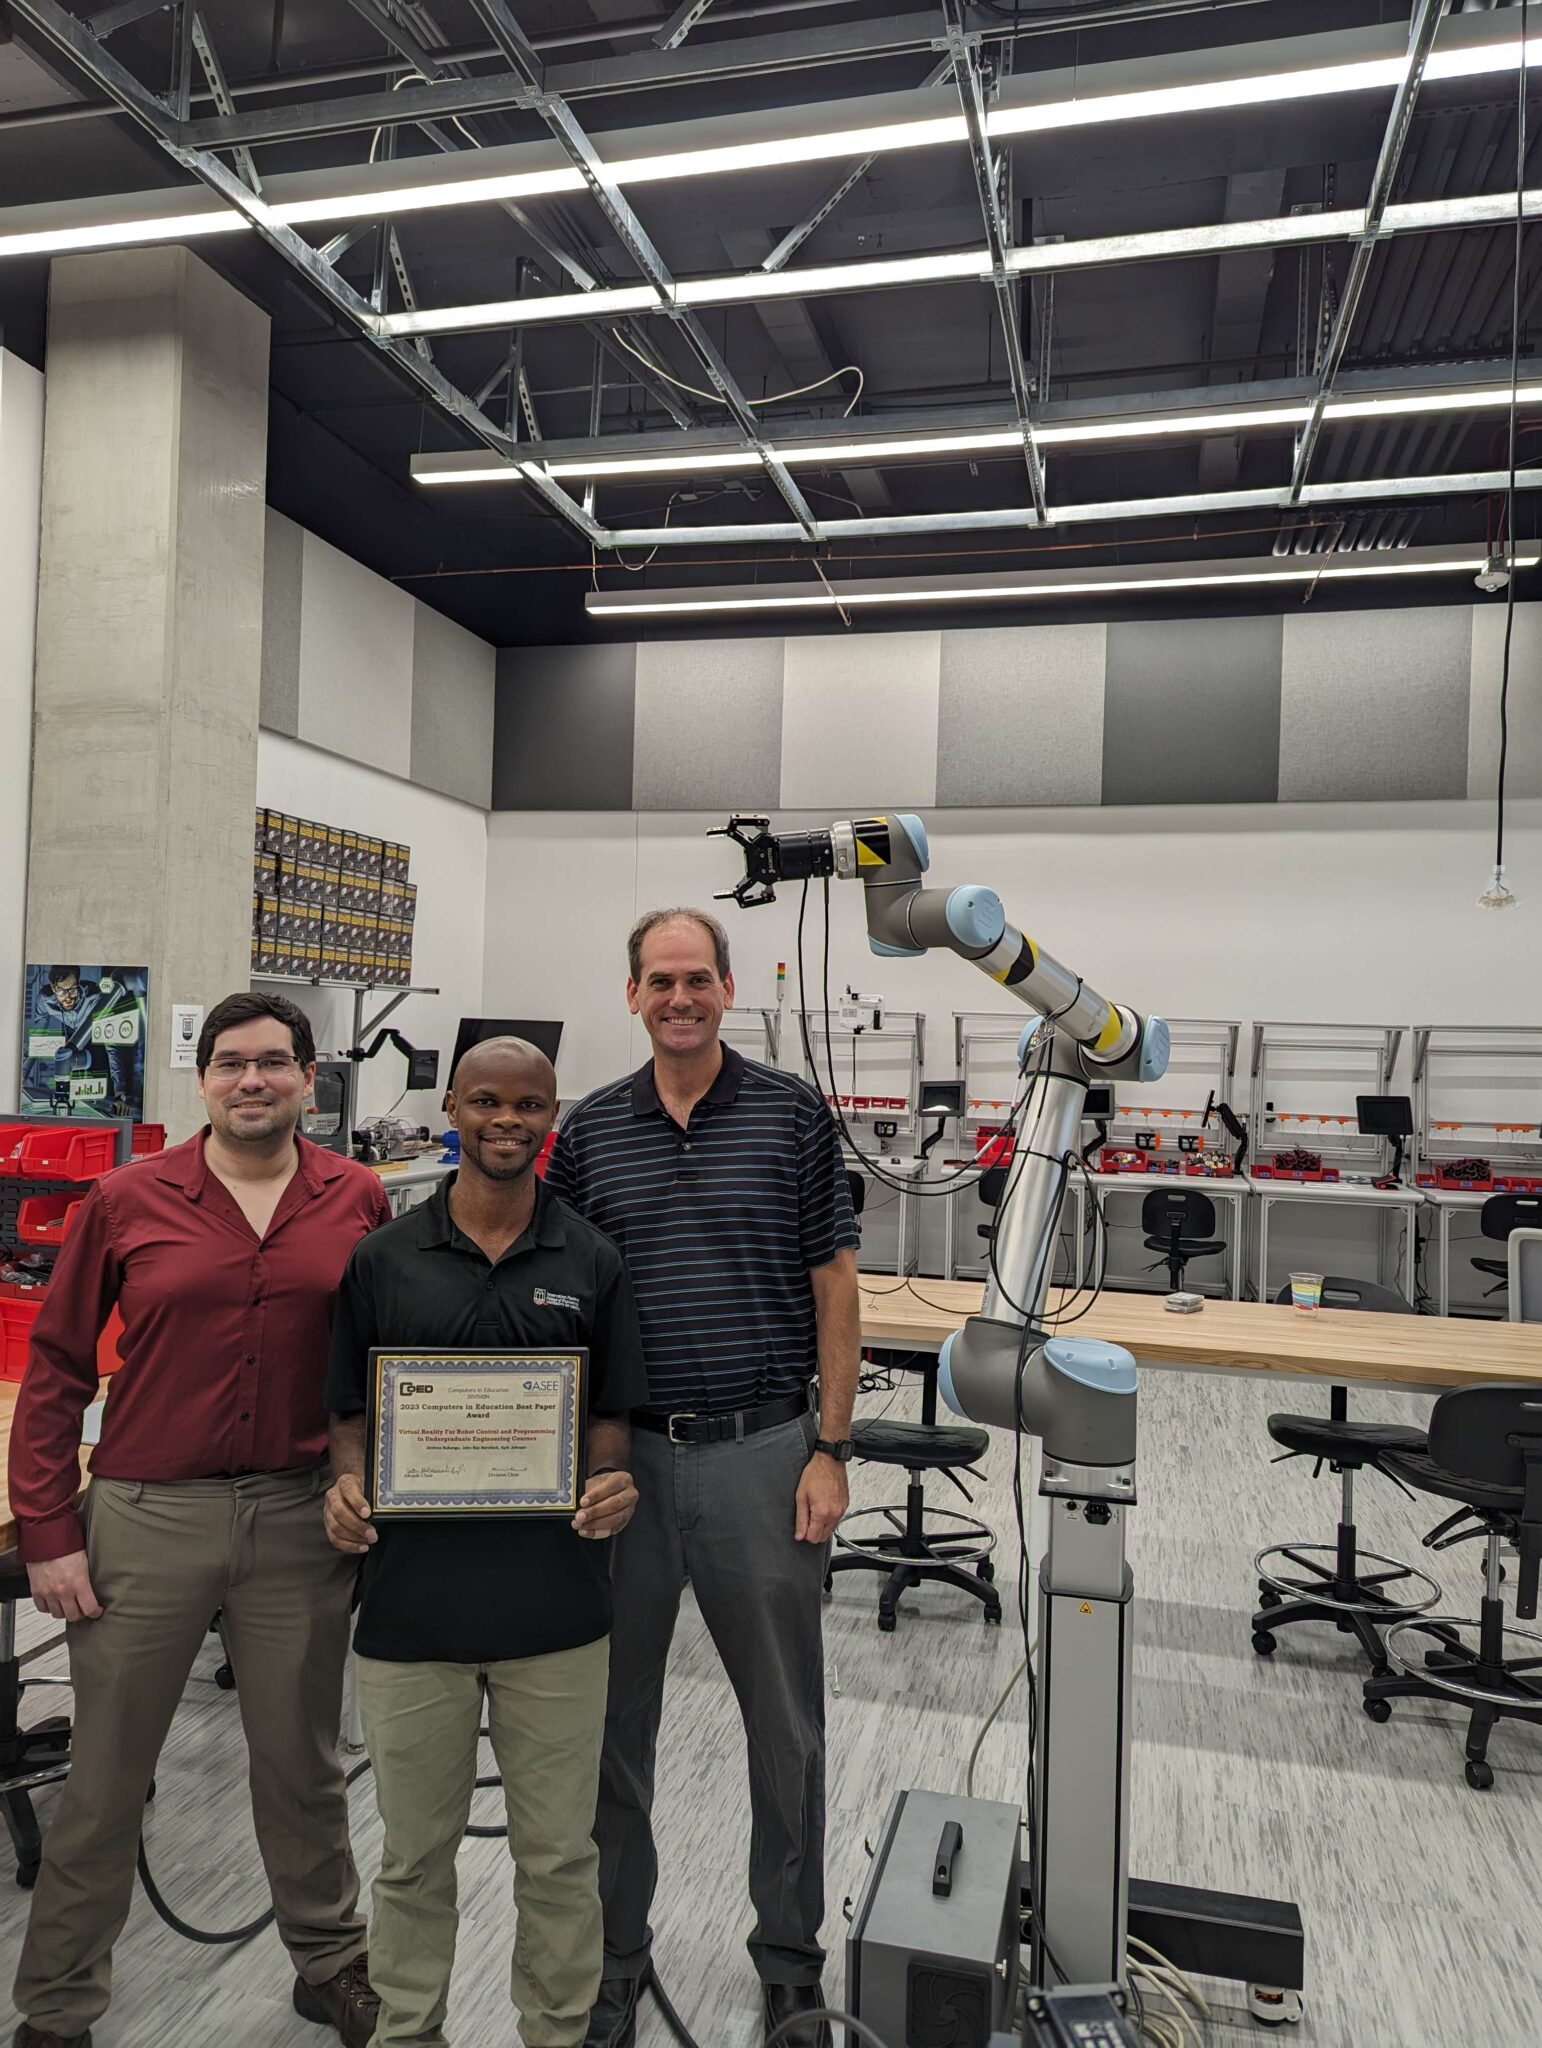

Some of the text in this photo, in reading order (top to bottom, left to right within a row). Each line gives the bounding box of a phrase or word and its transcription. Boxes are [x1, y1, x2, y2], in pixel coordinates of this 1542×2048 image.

[532, 1380, 559, 1391] ASEE
[422, 1403, 464, 1411] Computers
[535, 1403, 556, 1411] Paper
